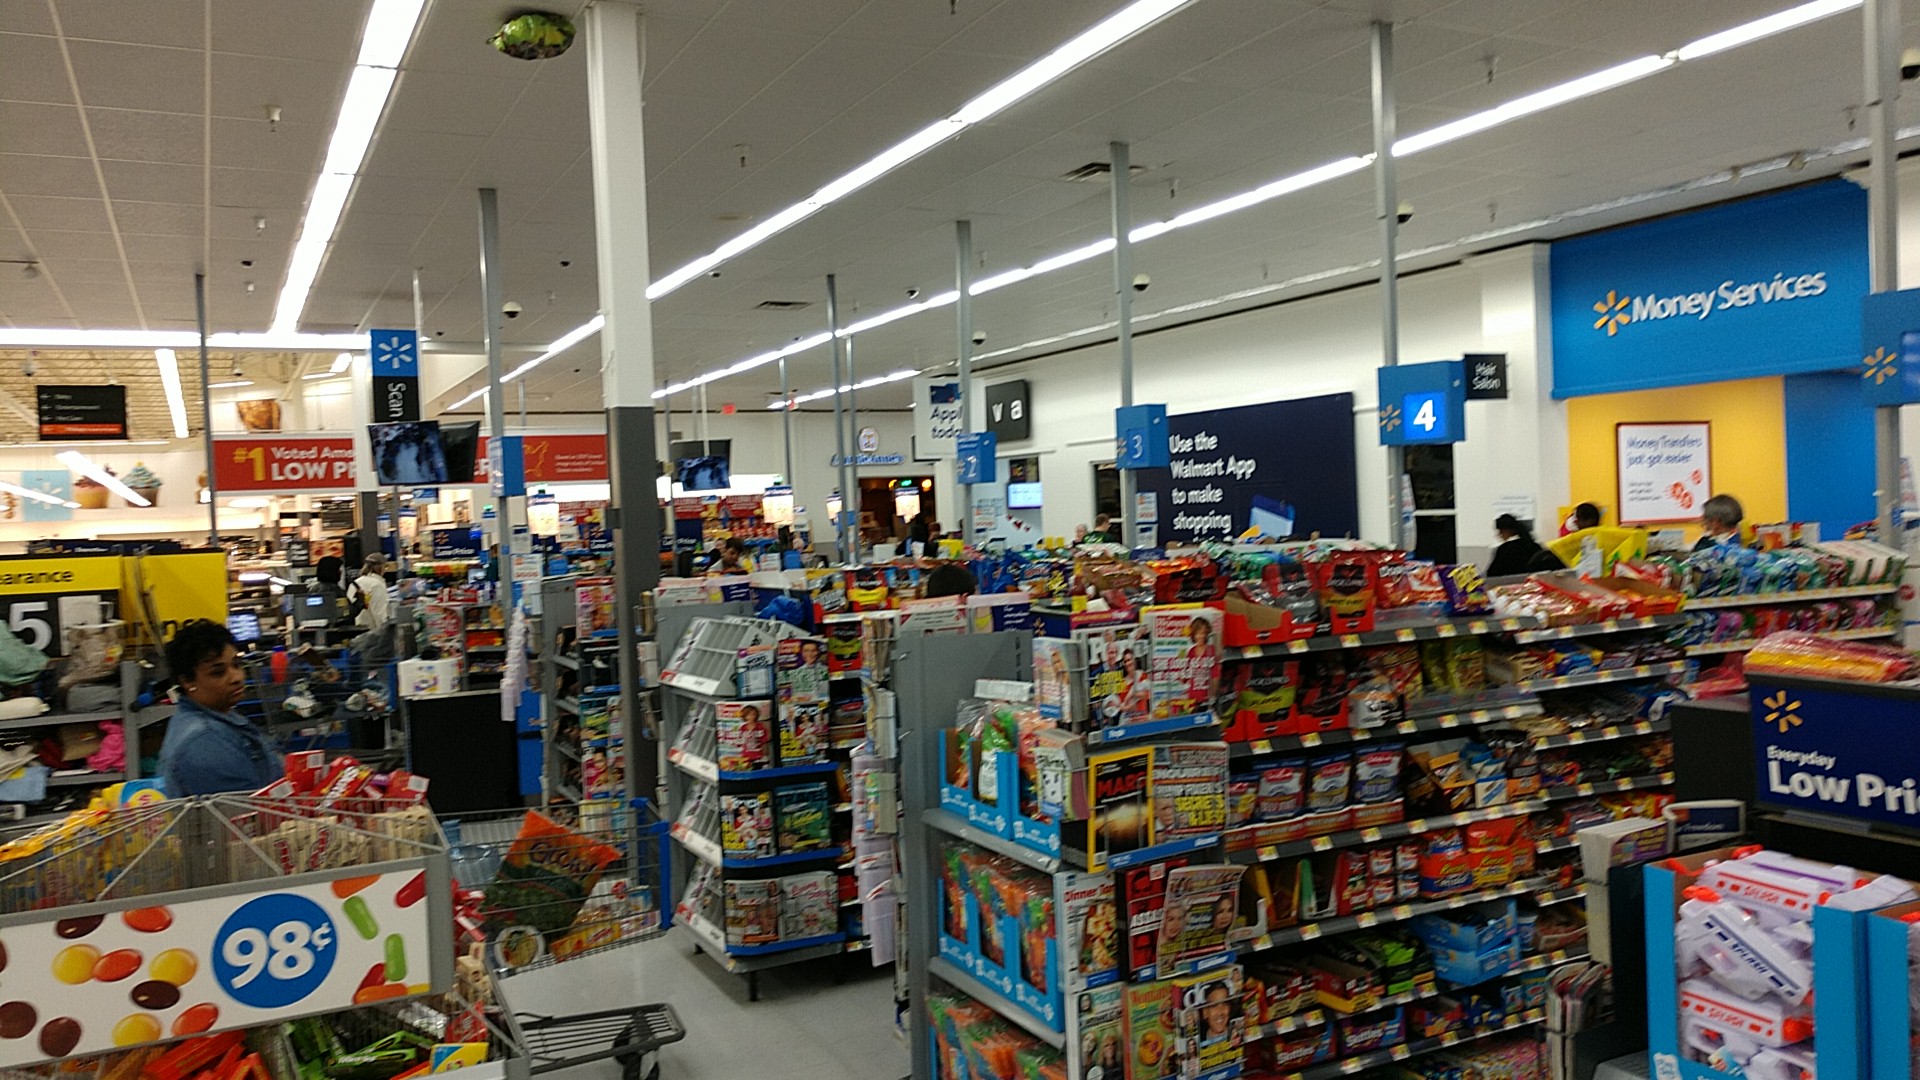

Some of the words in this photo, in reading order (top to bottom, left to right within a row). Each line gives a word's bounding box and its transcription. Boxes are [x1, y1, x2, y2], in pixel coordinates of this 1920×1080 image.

[1632, 290, 1716, 322] Money
[1717, 272, 1828, 310] Services
[1472, 375, 1501, 390] Salon
[387, 382, 407, 418] Scan
[930, 405, 964, 425] Appl
[1413, 399, 1437, 432] 4
[931, 426, 963, 439] toda
[1169, 434, 1194, 454] Use
[1195, 431, 1218, 451] the
[1132, 434, 1143, 459] 3
[232, 446, 266, 482] #1
[271, 447, 319, 460] Voted
[271, 461, 328, 481] LOW
[967, 456, 977, 478] 2
[1170, 458, 1225, 480] Walmart
[1226, 455, 1257, 481] App
[1172, 488, 1187, 505] to
[1188, 483, 1224, 504] make
[1172, 509, 1232, 535] shopping
[9, 601, 52, 651] 5
[1766, 745, 1837, 771] Everyday
[1768, 759, 1851, 804] Low
[1855, 773, 1920, 815] Pri
